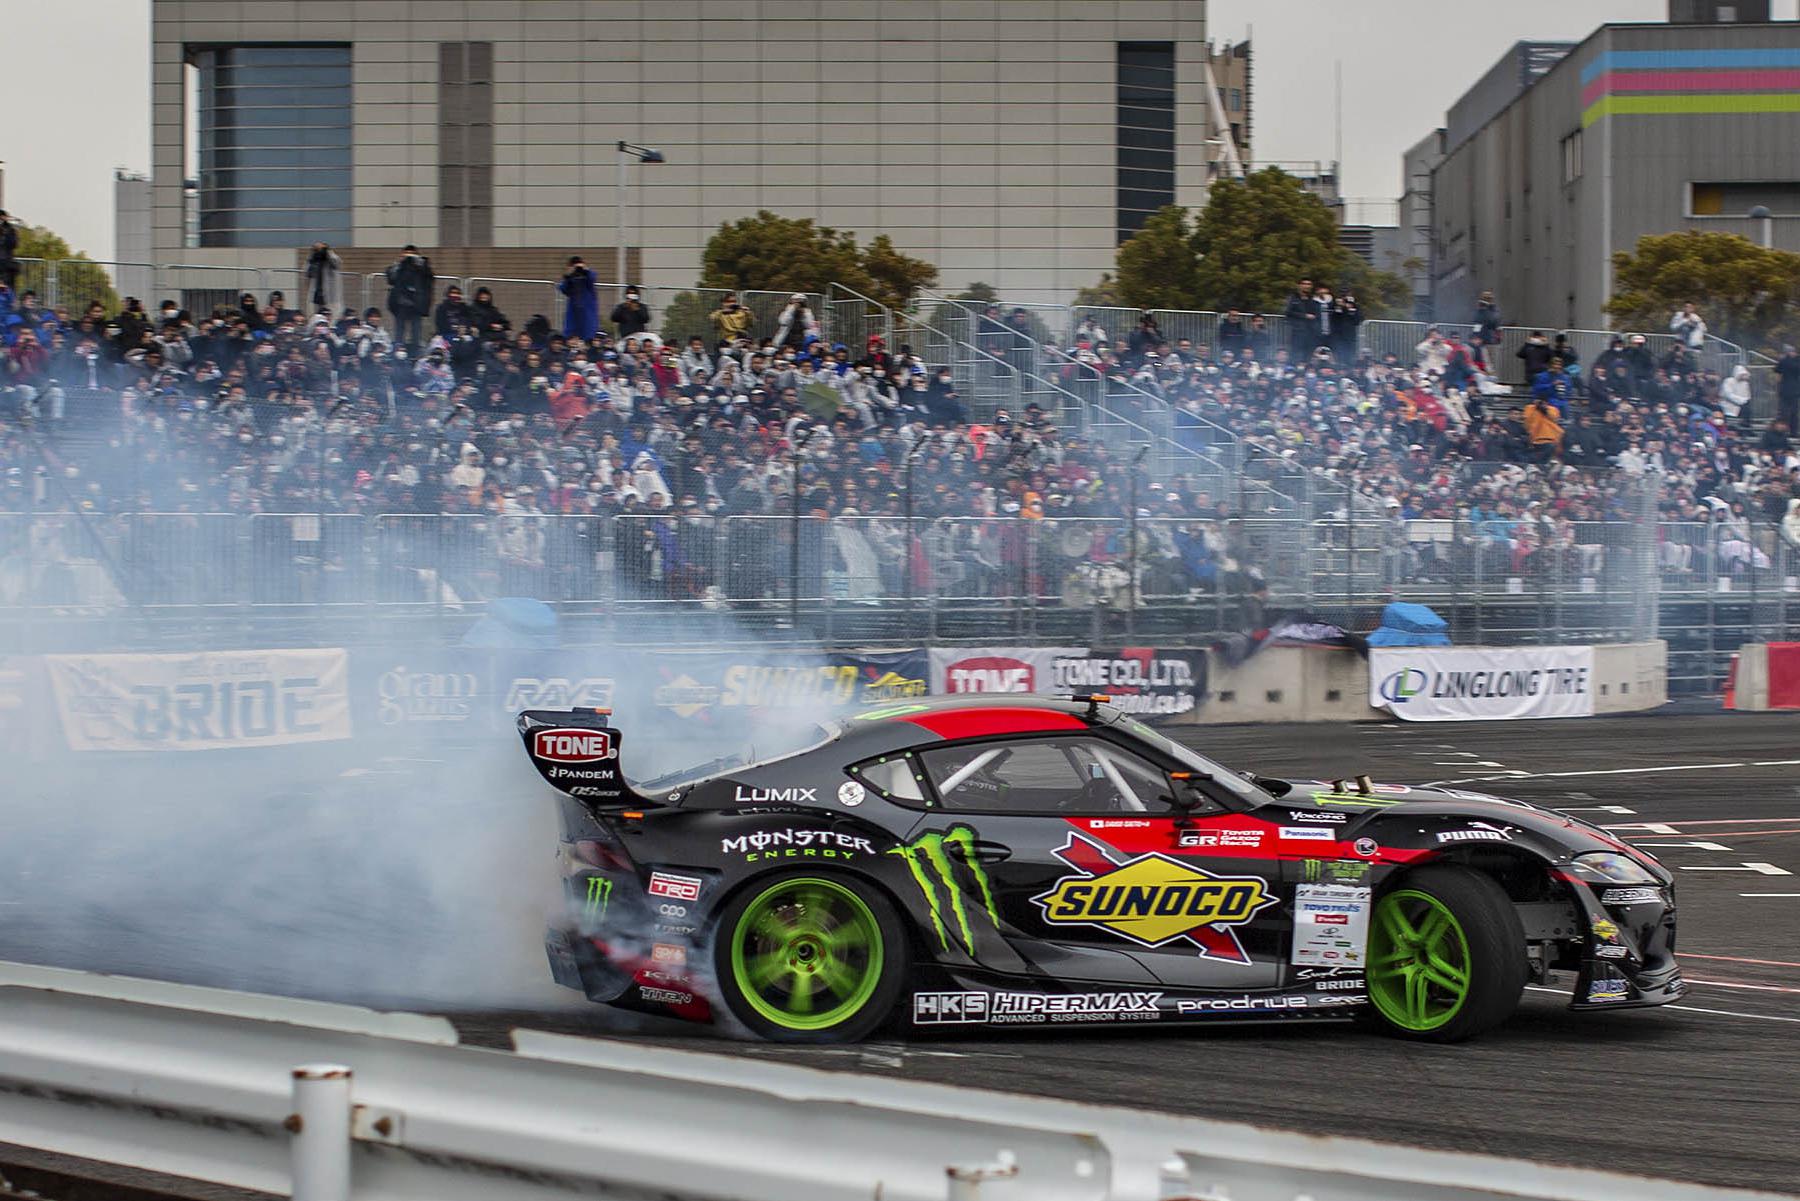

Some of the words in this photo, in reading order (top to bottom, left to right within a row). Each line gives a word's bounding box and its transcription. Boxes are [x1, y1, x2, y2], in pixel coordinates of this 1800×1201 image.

[721, 665, 859, 706] SUNOCO
[950, 668, 1031, 693] TONE
[1431, 671, 1543, 698] LINGLONG
[1546, 668, 1589, 694] TIRE
[130, 676, 322, 741] BRIDE
[542, 735, 604, 755] TONE
[559, 769, 614, 779] PANDEM
[735, 786, 817, 801] LUMIX
[1180, 836, 1217, 846] GR
[1285, 829, 1328, 838] Panasonic
[746, 848, 854, 862] ENERGY
[653, 880, 697, 897] TRD
[1055, 885, 1255, 916] SUNOCO
[1315, 979, 1366, 990] BRIDE
[917, 996, 987, 1014] HKS
[991, 992, 1164, 1013] HIPERMAX
[1177, 995, 1308, 1014] prodrive
[990, 1013, 1046, 1023] ADVANCED
[1051, 1013, 1115, 1022] SUSPENSION
[1119, 1011, 1160, 1020] SYSTEM
